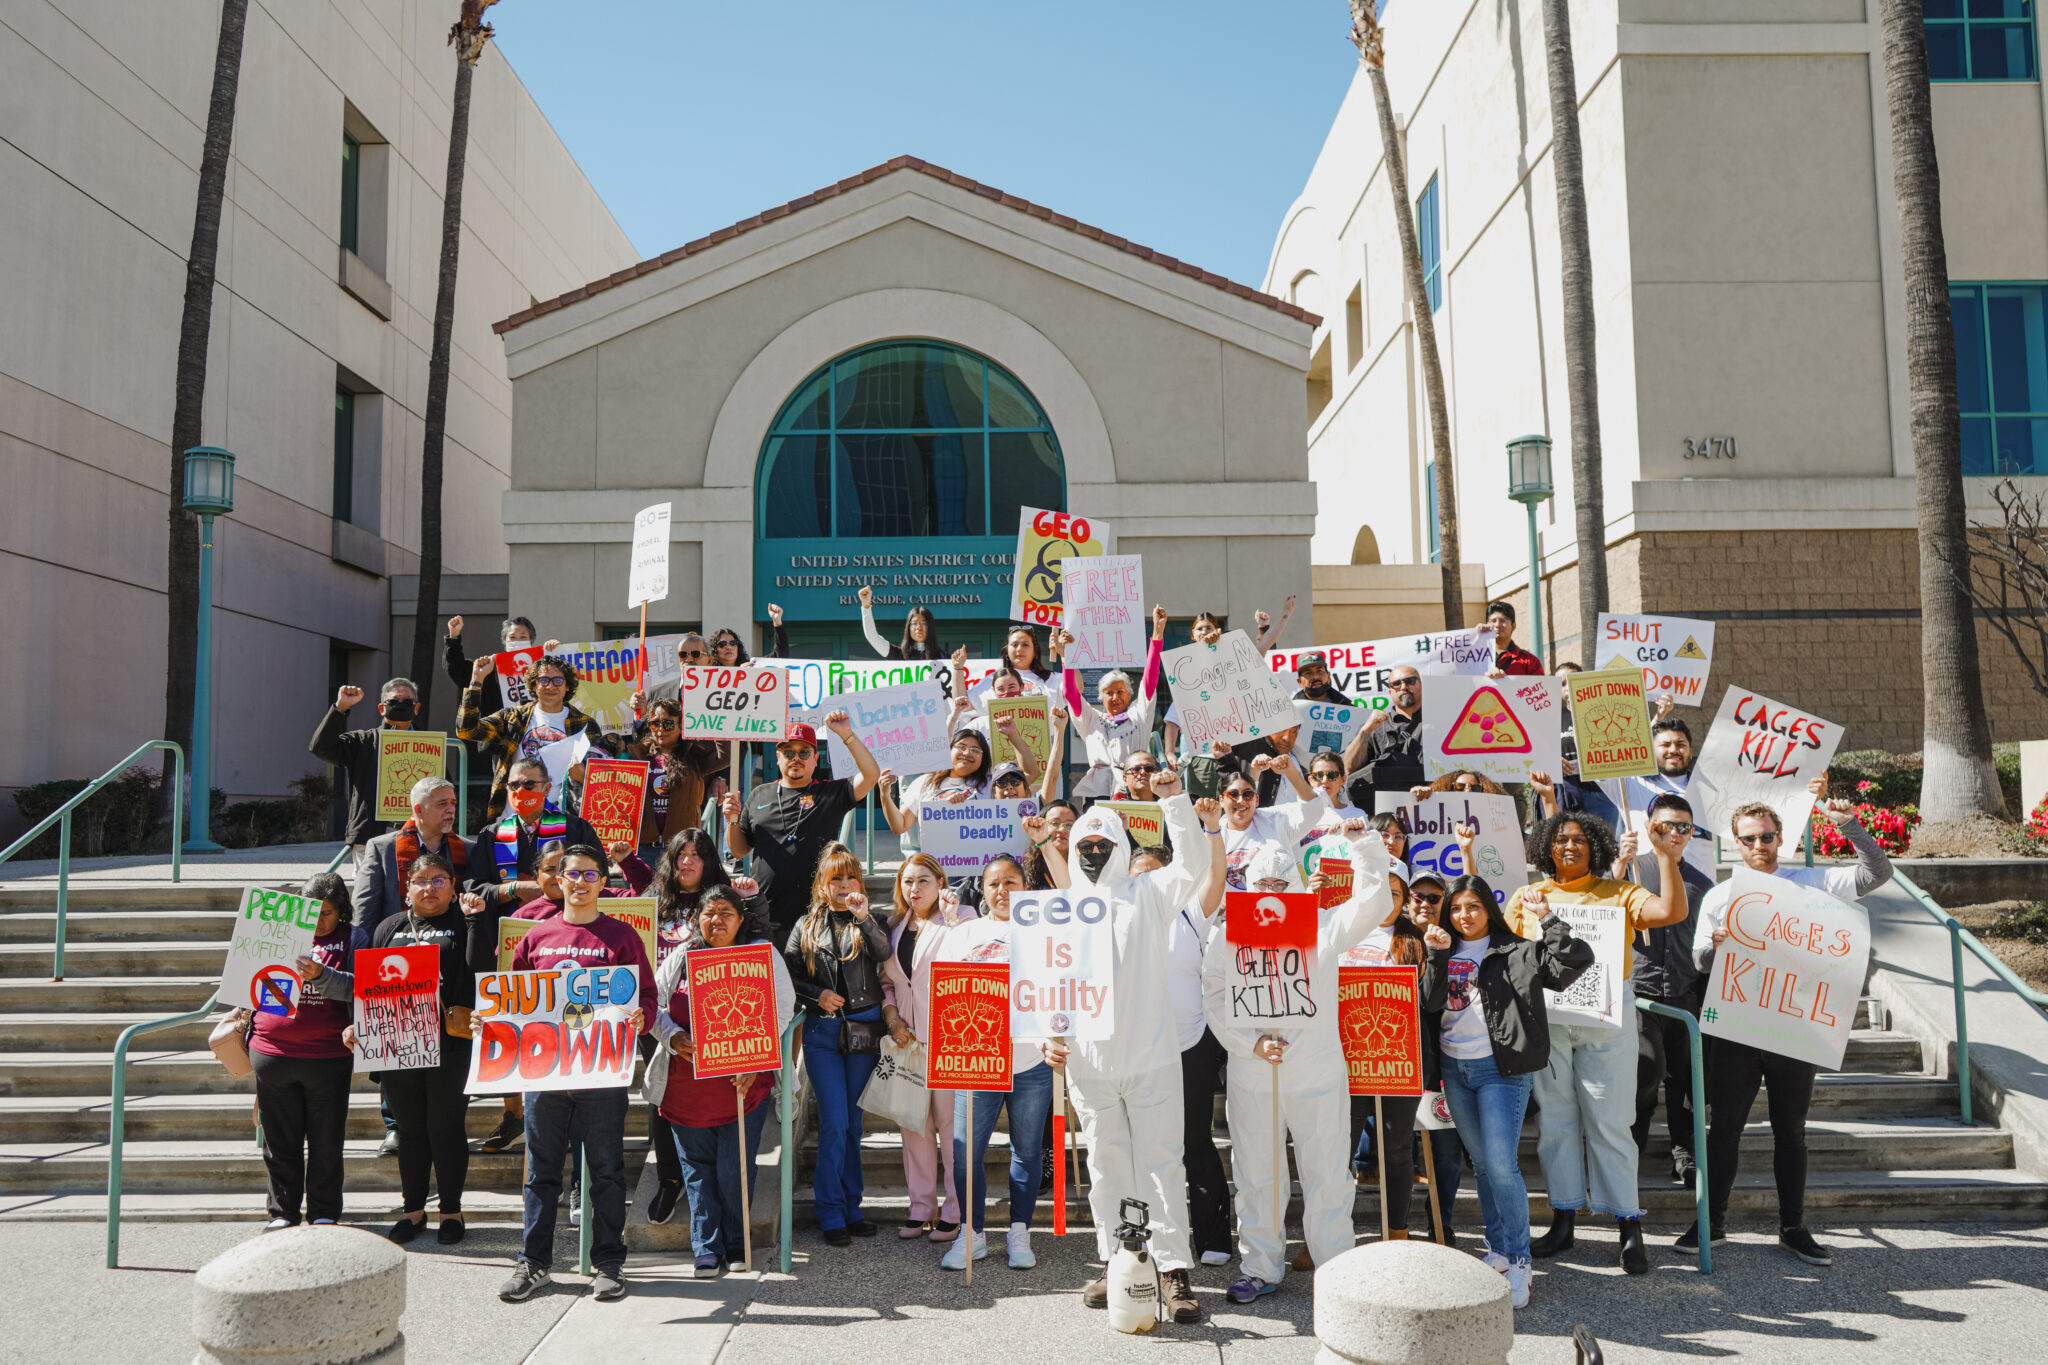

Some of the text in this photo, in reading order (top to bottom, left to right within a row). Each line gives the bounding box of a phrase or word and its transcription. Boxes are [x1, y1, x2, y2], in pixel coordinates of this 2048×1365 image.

[1683, 437, 1739, 459] 3470
[1033, 511, 1091, 543] GEO
[791, 553, 1017, 568] UNITED STATES DISTRICT COU
[776, 575, 833, 587] UNITED
[837, 574, 888, 586] STATES
[893, 573, 991, 586] BANKRUPTCY
[1065, 565, 1139, 605] FREE
[839, 593, 982, 606] RIVRSIDE, CALIFORNIA
[1023, 600, 1064, 626] POI
[1077, 605, 1132, 626] THEM
[1606, 619, 1662, 643] SHUT
[1071, 630, 1134, 664] ALL
[1440, 647, 1494, 664] LIGAYA
[1637, 646, 1669, 662] GEO
[1271, 646, 1377, 673] PPLE
[684, 667, 747, 690] STOP
[1173, 655, 1236, 692] Cage
[1332, 668, 1392, 693] VER
[1643, 667, 1702, 696] DOWN
[1576, 682, 1641, 703] SHUT DOWN
[685, 712, 727, 731] SAVE
[1018, 707, 1045, 721] DOWN
[1182, 697, 1244, 747] Blood
[1310, 705, 1351, 723] GEO
[1734, 696, 1826, 750] CAGES
[384, 742, 441, 757] SHUT DOWN
[1586, 746, 1649, 765] ADELANTO
[1737, 730, 1800, 780] KILL
[590, 771, 642, 788] SHUT DOWN
[383, 796, 412, 808] ADEL
[922, 806, 992, 821] Detention
[1396, 799, 1481, 836] Abolih
[596, 827, 634, 841] ELANTO
[959, 824, 1013, 841] Deadly!
[1128, 816, 1159, 833] DOWN
[937, 854, 979, 866] utdown
[1327, 873, 1353, 888] HUT
[245, 889, 322, 931] PEOPLE
[1592, 908, 1617, 920] LETTER
[259, 921, 292, 940] OVER
[1570, 923, 1598, 931] ENATOR
[1726, 891, 1852, 958] CAGES
[504, 936, 522, 952] SH
[1046, 936, 1073, 968] Is
[1235, 945, 1299, 978] GEO
[695, 962, 727, 986] SHUT
[730, 961, 768, 980] DOWN
[479, 967, 637, 1017] SHUT GEO
[935, 977, 1008, 999] SHUT DOWN
[1012, 978, 1108, 1019] Guilty
[1231, 978, 1318, 1018] KILLS
[1338, 982, 1412, 1003] SHUT DOWN
[1721, 952, 1836, 1027] KILL
[366, 998, 398, 1020] How
[358, 1018, 425, 1037] Lives Do
[358, 1033, 436, 1060] You Need To
[477, 1017, 639, 1083] DOWN!
[702, 1036, 773, 1059] ADELANTO
[398, 1049, 440, 1069] RUIN?
[716, 1055, 749, 1065] PROCESSING
[750, 1053, 769, 1062] CENTER
[935, 1055, 1006, 1073] ADELANTO
